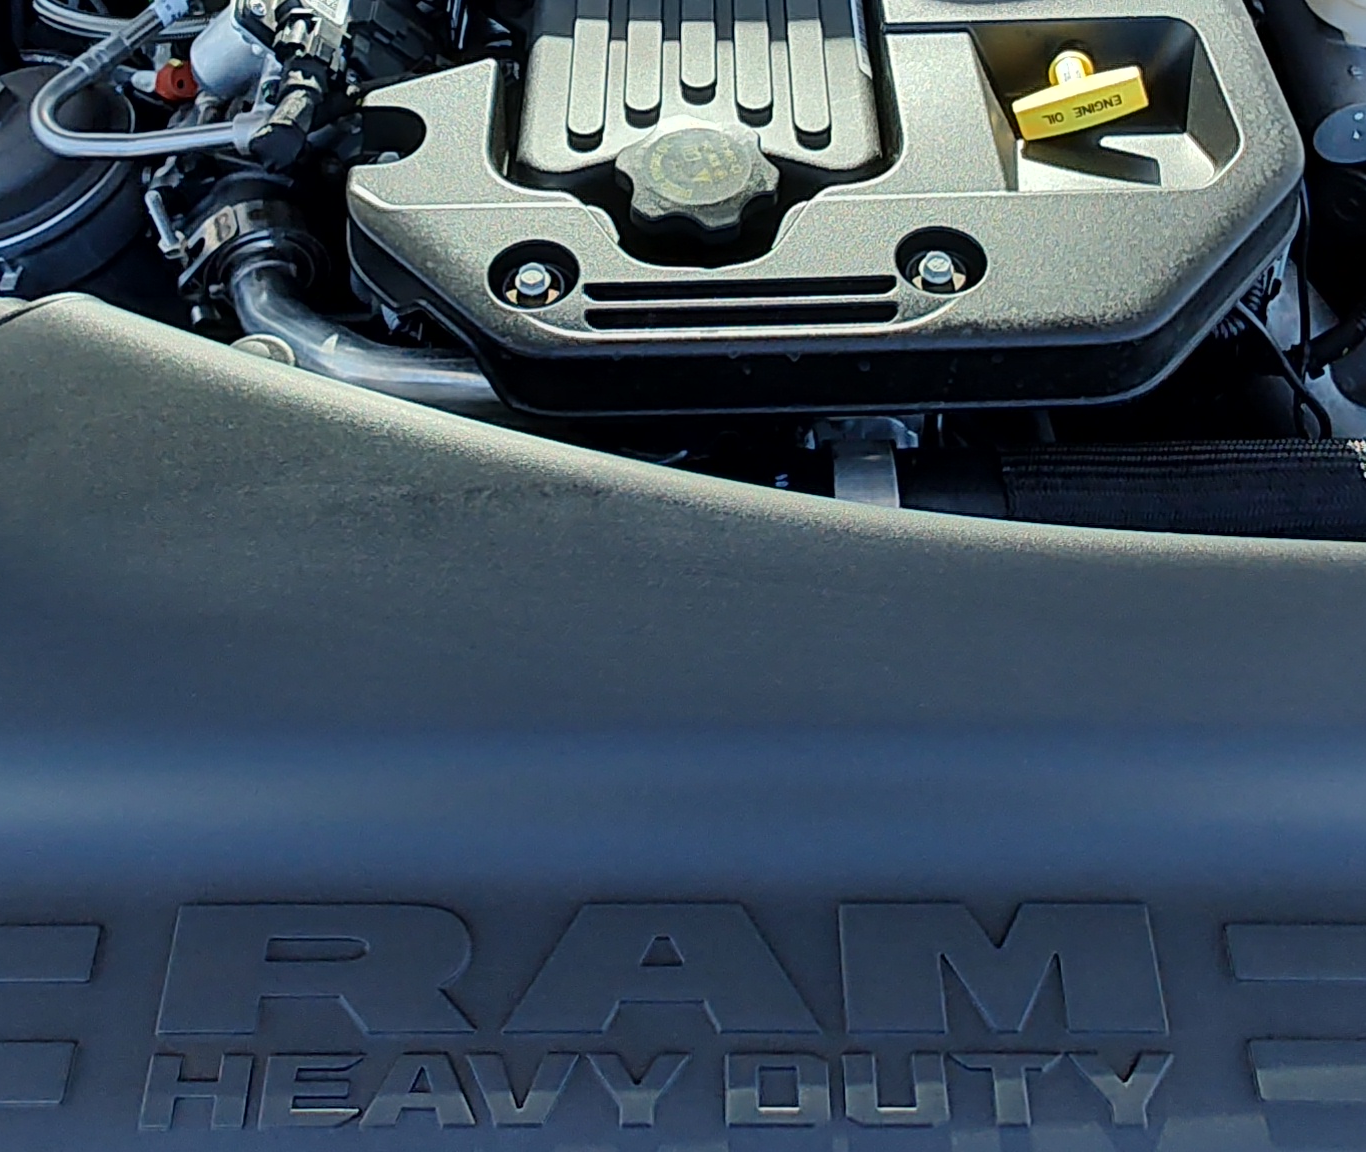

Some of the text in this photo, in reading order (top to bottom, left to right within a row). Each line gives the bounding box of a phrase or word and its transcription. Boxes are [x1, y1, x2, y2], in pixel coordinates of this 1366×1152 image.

[1041, 94, 1124, 125] ENGINE OIL
[154, 901, 1171, 1038] RAM
[138, 1051, 1175, 1132] HEAVY DUTY
